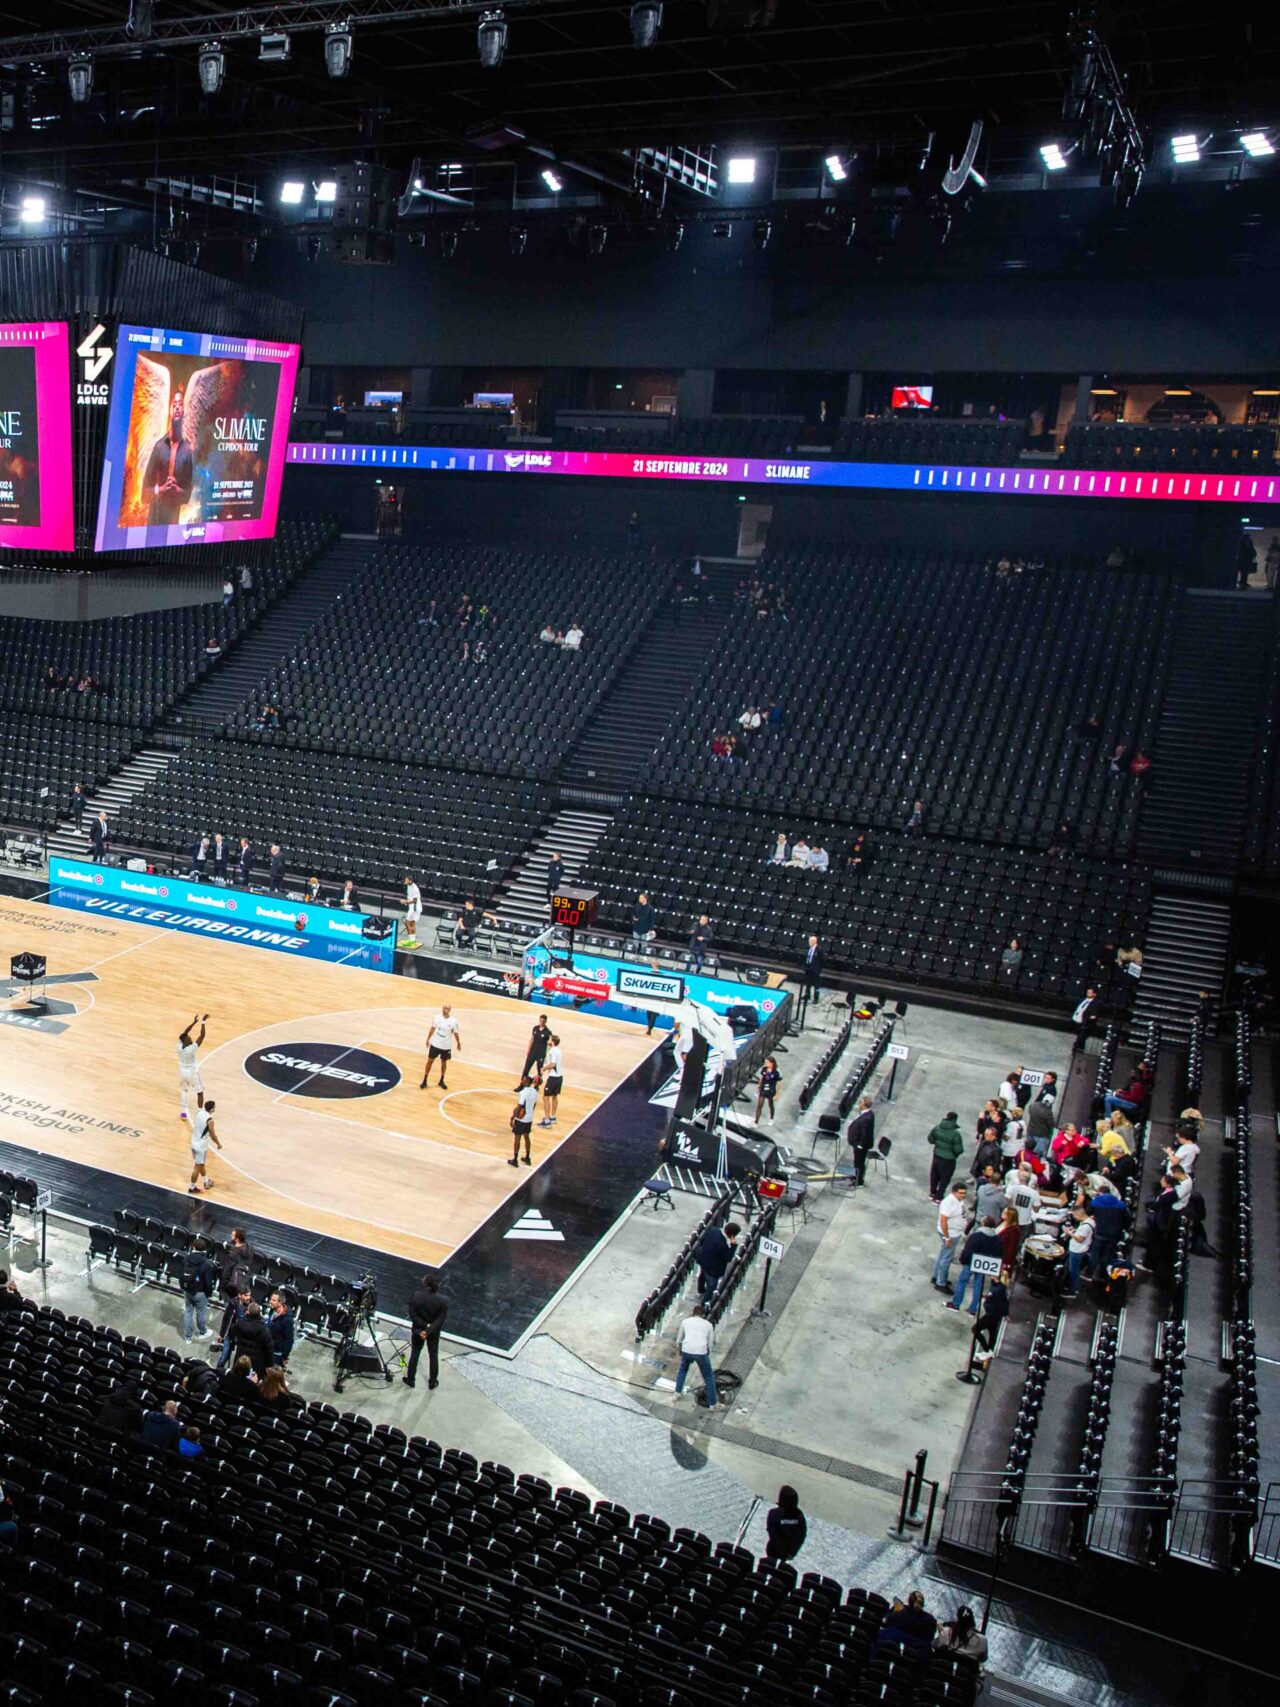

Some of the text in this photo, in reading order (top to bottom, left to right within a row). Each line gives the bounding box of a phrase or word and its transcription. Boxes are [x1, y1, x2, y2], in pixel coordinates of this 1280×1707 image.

[77, 384, 108, 395] LDLC
[77, 396, 108, 405] ASVEL
[214, 417, 267, 440] SLIMANE
[218, 442, 258, 452] CUPIDON TOUR
[525, 454, 551, 466] LDLC
[633, 460, 728, 475] 21 SEPTEMBRE 2024
[766, 465, 810, 479] SLIMANE
[58, 869, 93, 883] DenizBank
[121, 881, 158, 895] DenizBank
[187, 893, 225, 908] DenizBank
[577, 900, 585, 911] 0
[256, 906, 296, 922] DenizBank
[557, 909, 579, 925] 0.0
[55, 920, 119, 937] AIRLINES
[85, 897, 310, 948] VILLEURBANNE
[624, 977, 677, 993] SKWEEK
[707, 991, 760, 1010] DenizBank
[891, 1046, 904, 1055] 013
[260, 1053, 390, 1087] SKWEEK
[1023, 1073, 1041, 1084] 001
[52, 1109, 144, 1138] AIRLINES
[764, 1241, 778, 1253] 014
[973, 1259, 999, 1272] 002
